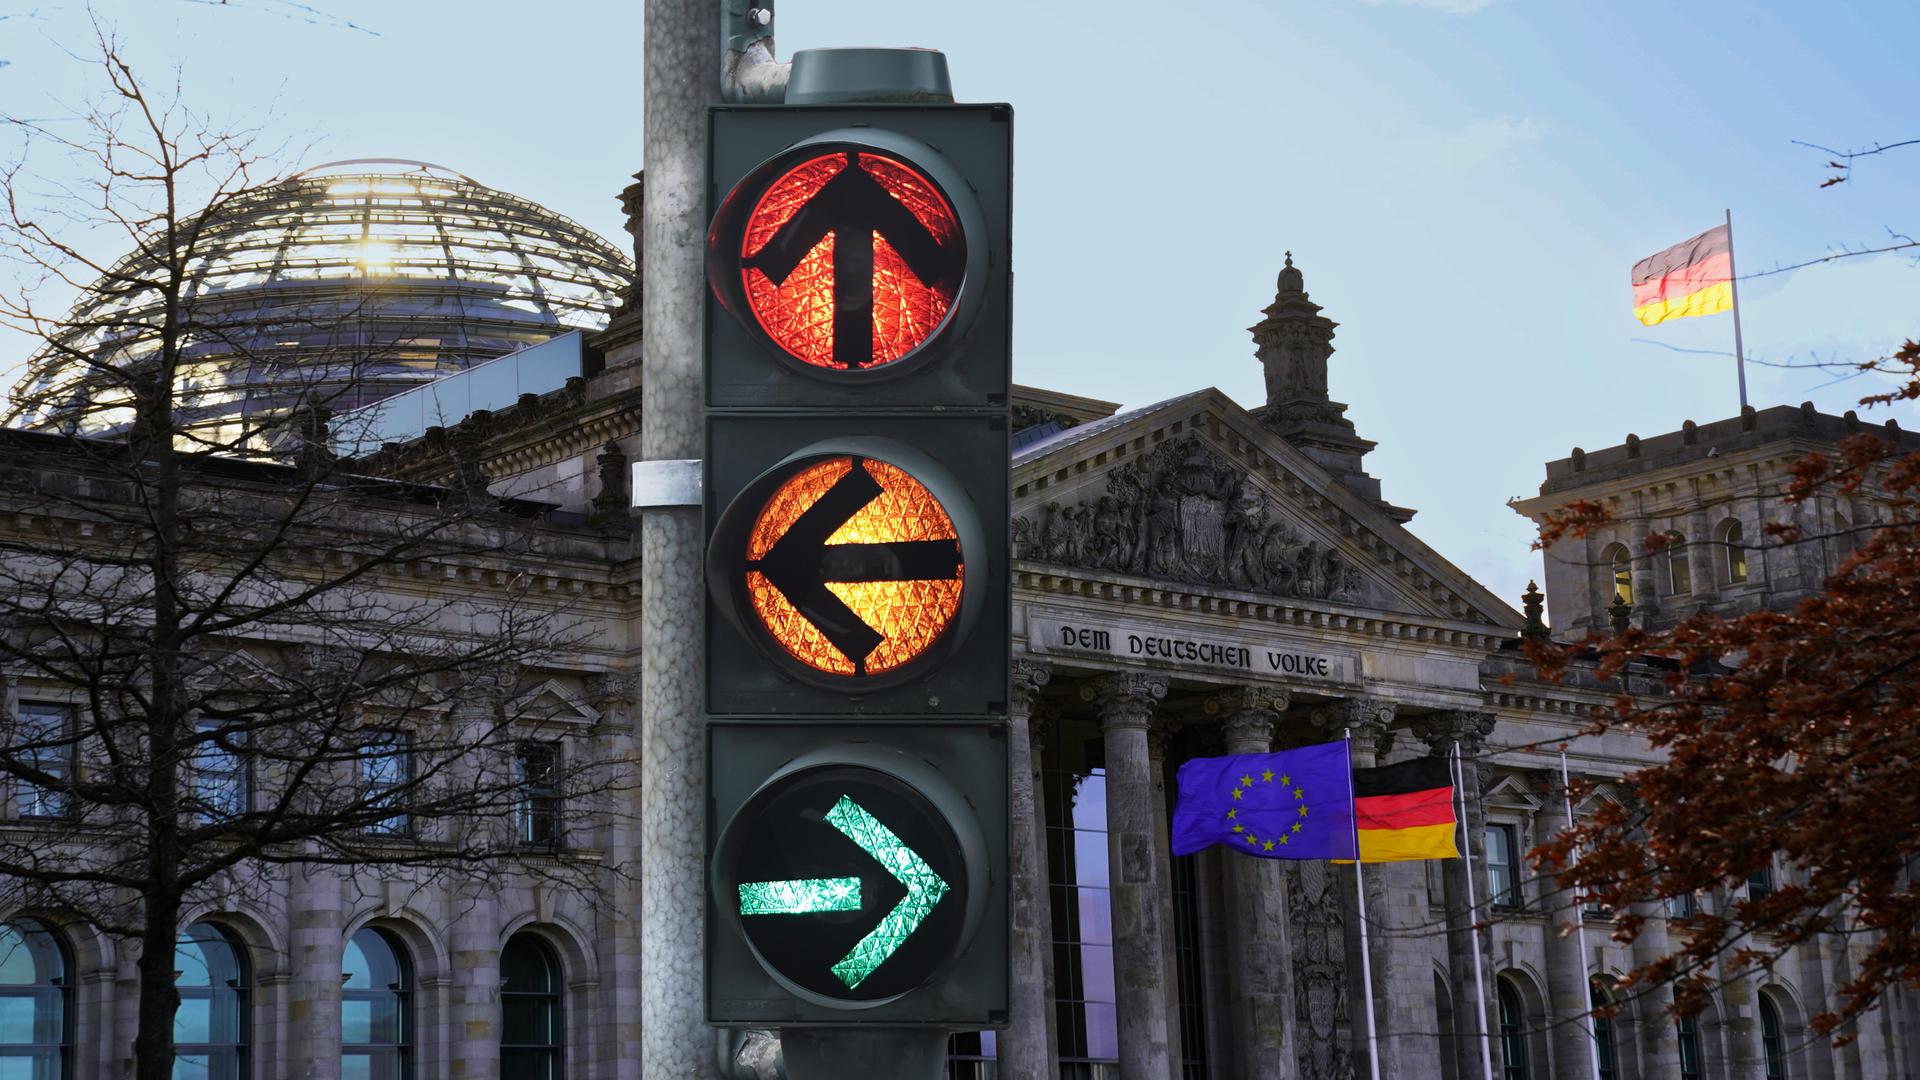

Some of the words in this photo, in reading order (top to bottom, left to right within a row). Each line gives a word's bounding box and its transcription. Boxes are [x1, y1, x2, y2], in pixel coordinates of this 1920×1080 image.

[1061, 626, 1110, 650] DEM
[1128, 635, 1251, 667] DEUTSCHEN
[1267, 652, 1328, 676] VOLKE
